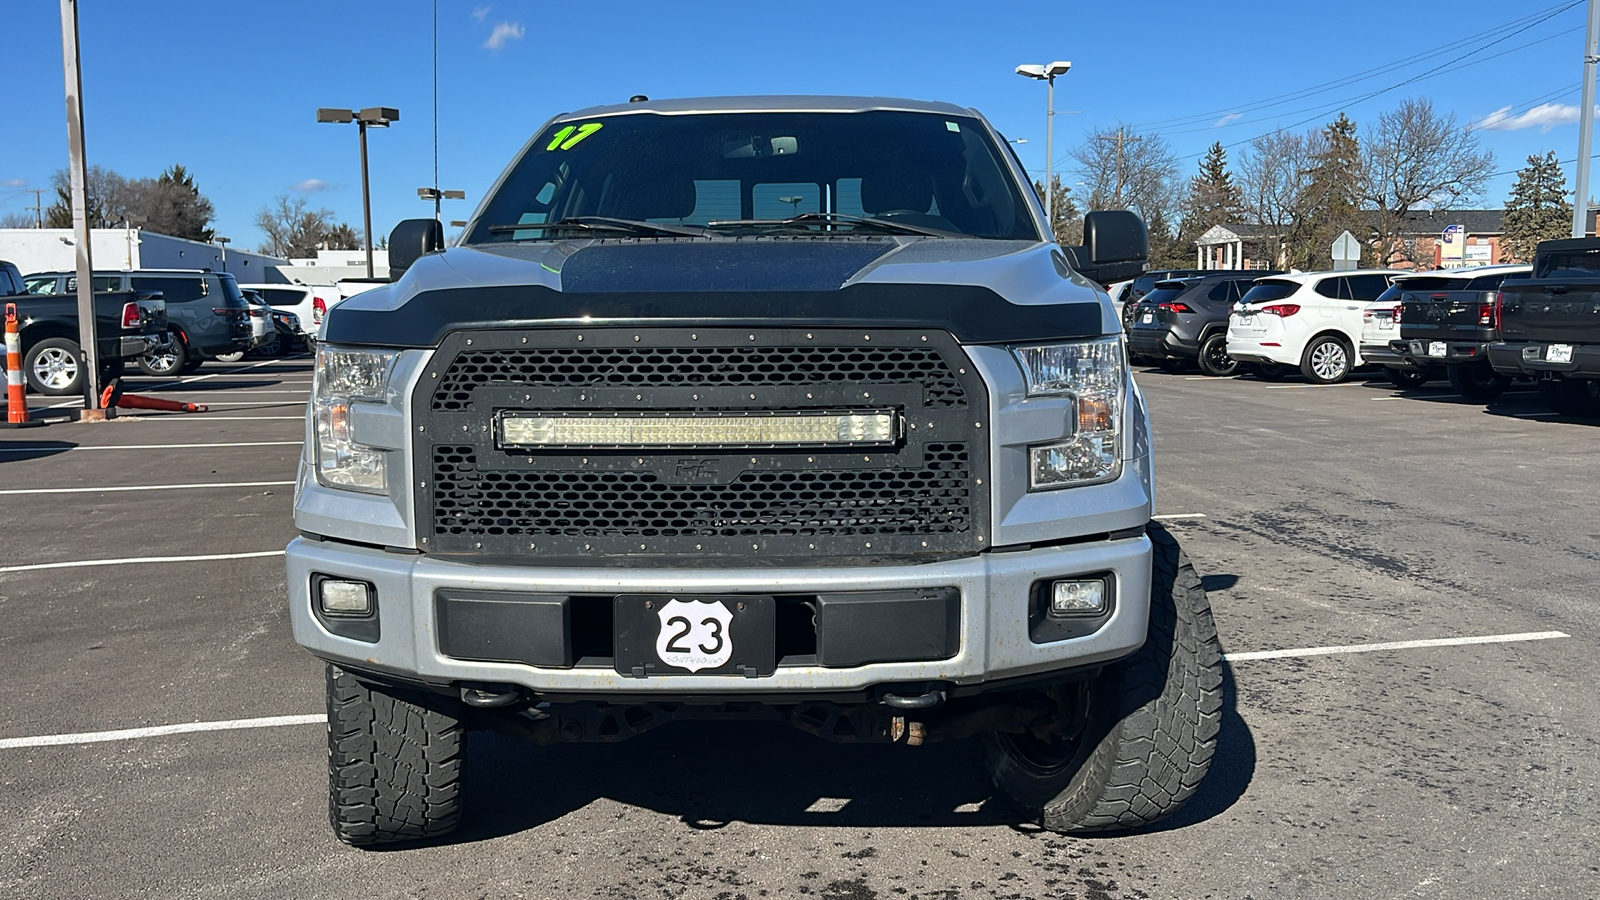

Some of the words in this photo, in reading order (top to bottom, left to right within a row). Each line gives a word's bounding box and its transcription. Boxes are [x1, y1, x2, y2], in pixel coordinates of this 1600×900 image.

[546, 123, 604, 151] 17
[665, 615, 724, 655] 23
[666, 655, 724, 665] SOUTHBOUND
